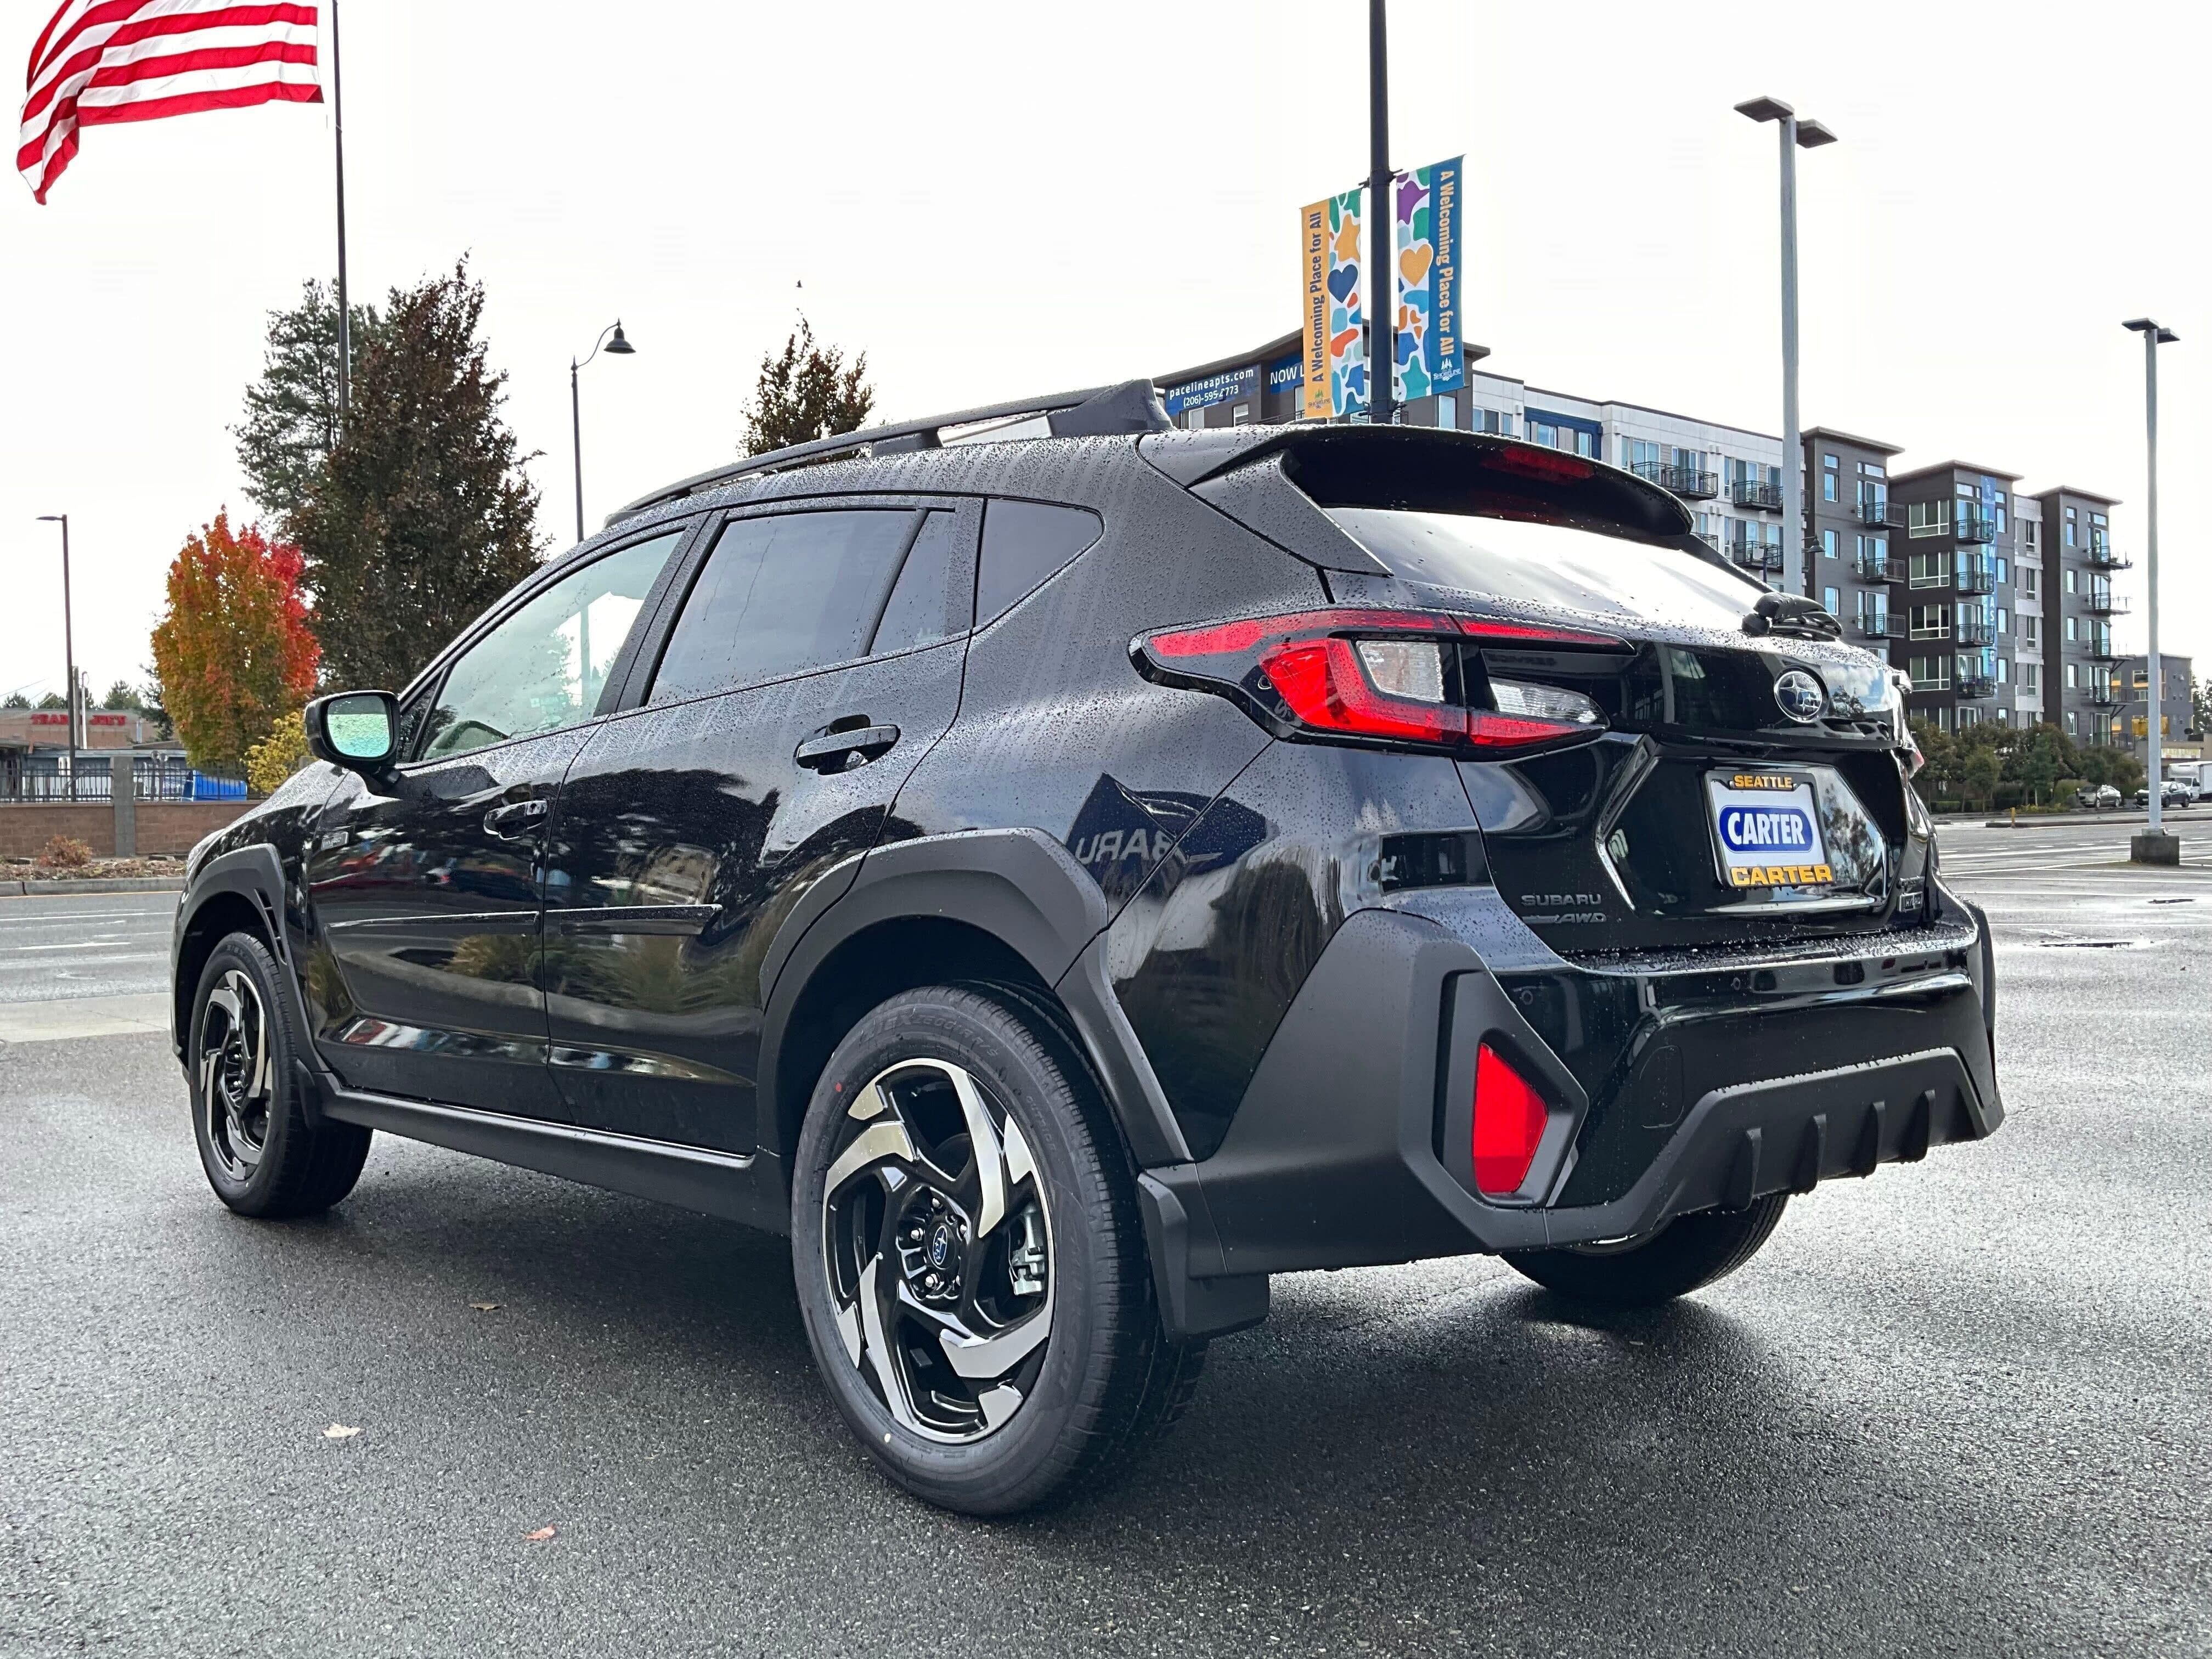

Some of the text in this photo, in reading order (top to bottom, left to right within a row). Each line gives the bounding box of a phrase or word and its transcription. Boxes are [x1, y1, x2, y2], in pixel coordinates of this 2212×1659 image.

[1440, 171, 1454, 182] A
[1436, 182, 1454, 266] Welcoming
[1310, 211, 1325, 382] A Welcoming Place for All
[1439, 267, 1454, 308] Place
[1440, 310, 1454, 332] for
[1440, 336, 1454, 356] All
[1169, 368, 1254, 400] pacelineapts.com
[1270, 366, 1297, 385] NOW
[1734, 775, 1793, 788] SEATTLE
[1728, 812, 1805, 845] CARTER
[1731, 865, 1833, 886] CARTER
[1521, 894, 1602, 906] SUBARU
[1556, 912, 1607, 923] AWD
